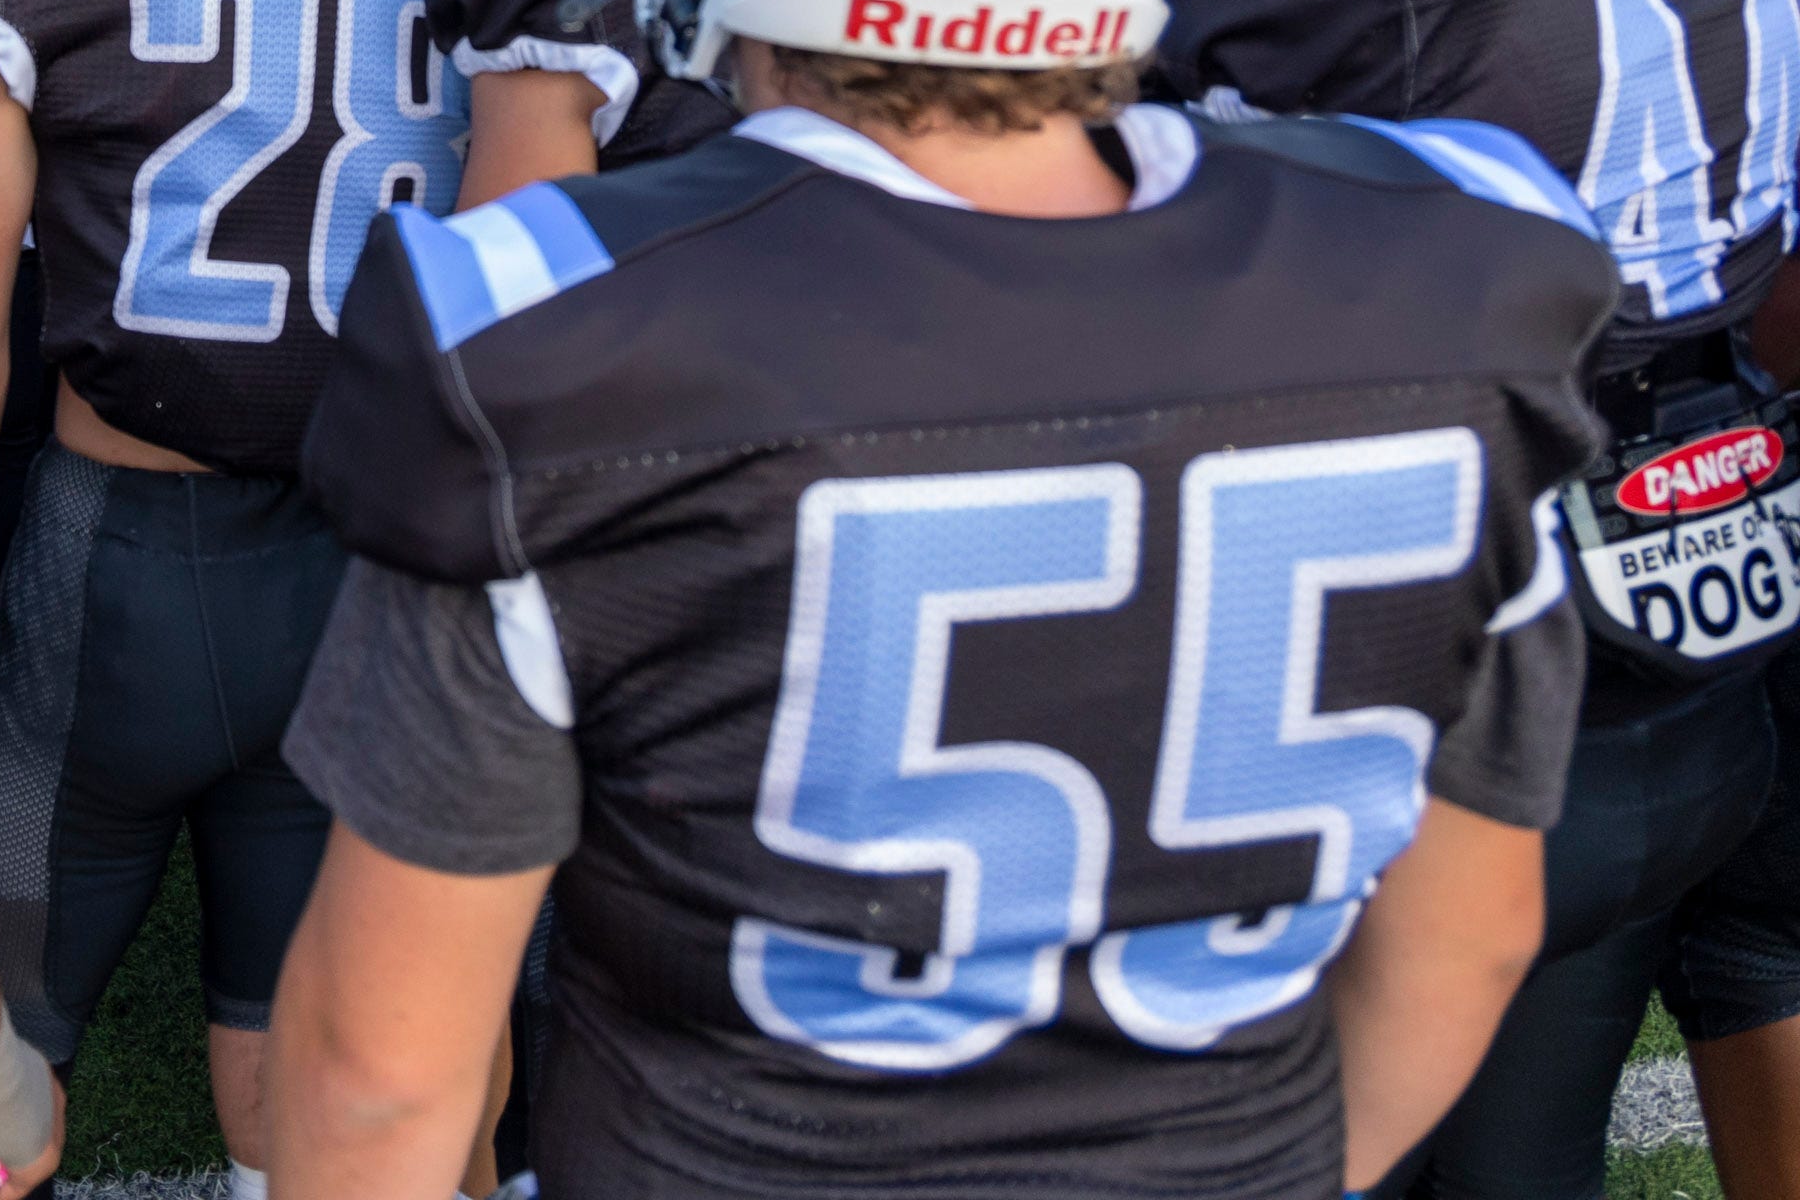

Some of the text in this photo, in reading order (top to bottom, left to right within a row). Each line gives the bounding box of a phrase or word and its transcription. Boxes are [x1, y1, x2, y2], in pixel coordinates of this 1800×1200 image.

[1641, 432, 1775, 507] DANGER
[1618, 521, 1736, 579] BEWARE
[1627, 546, 1786, 651] DOG
[730, 425, 1488, 1075] 55
